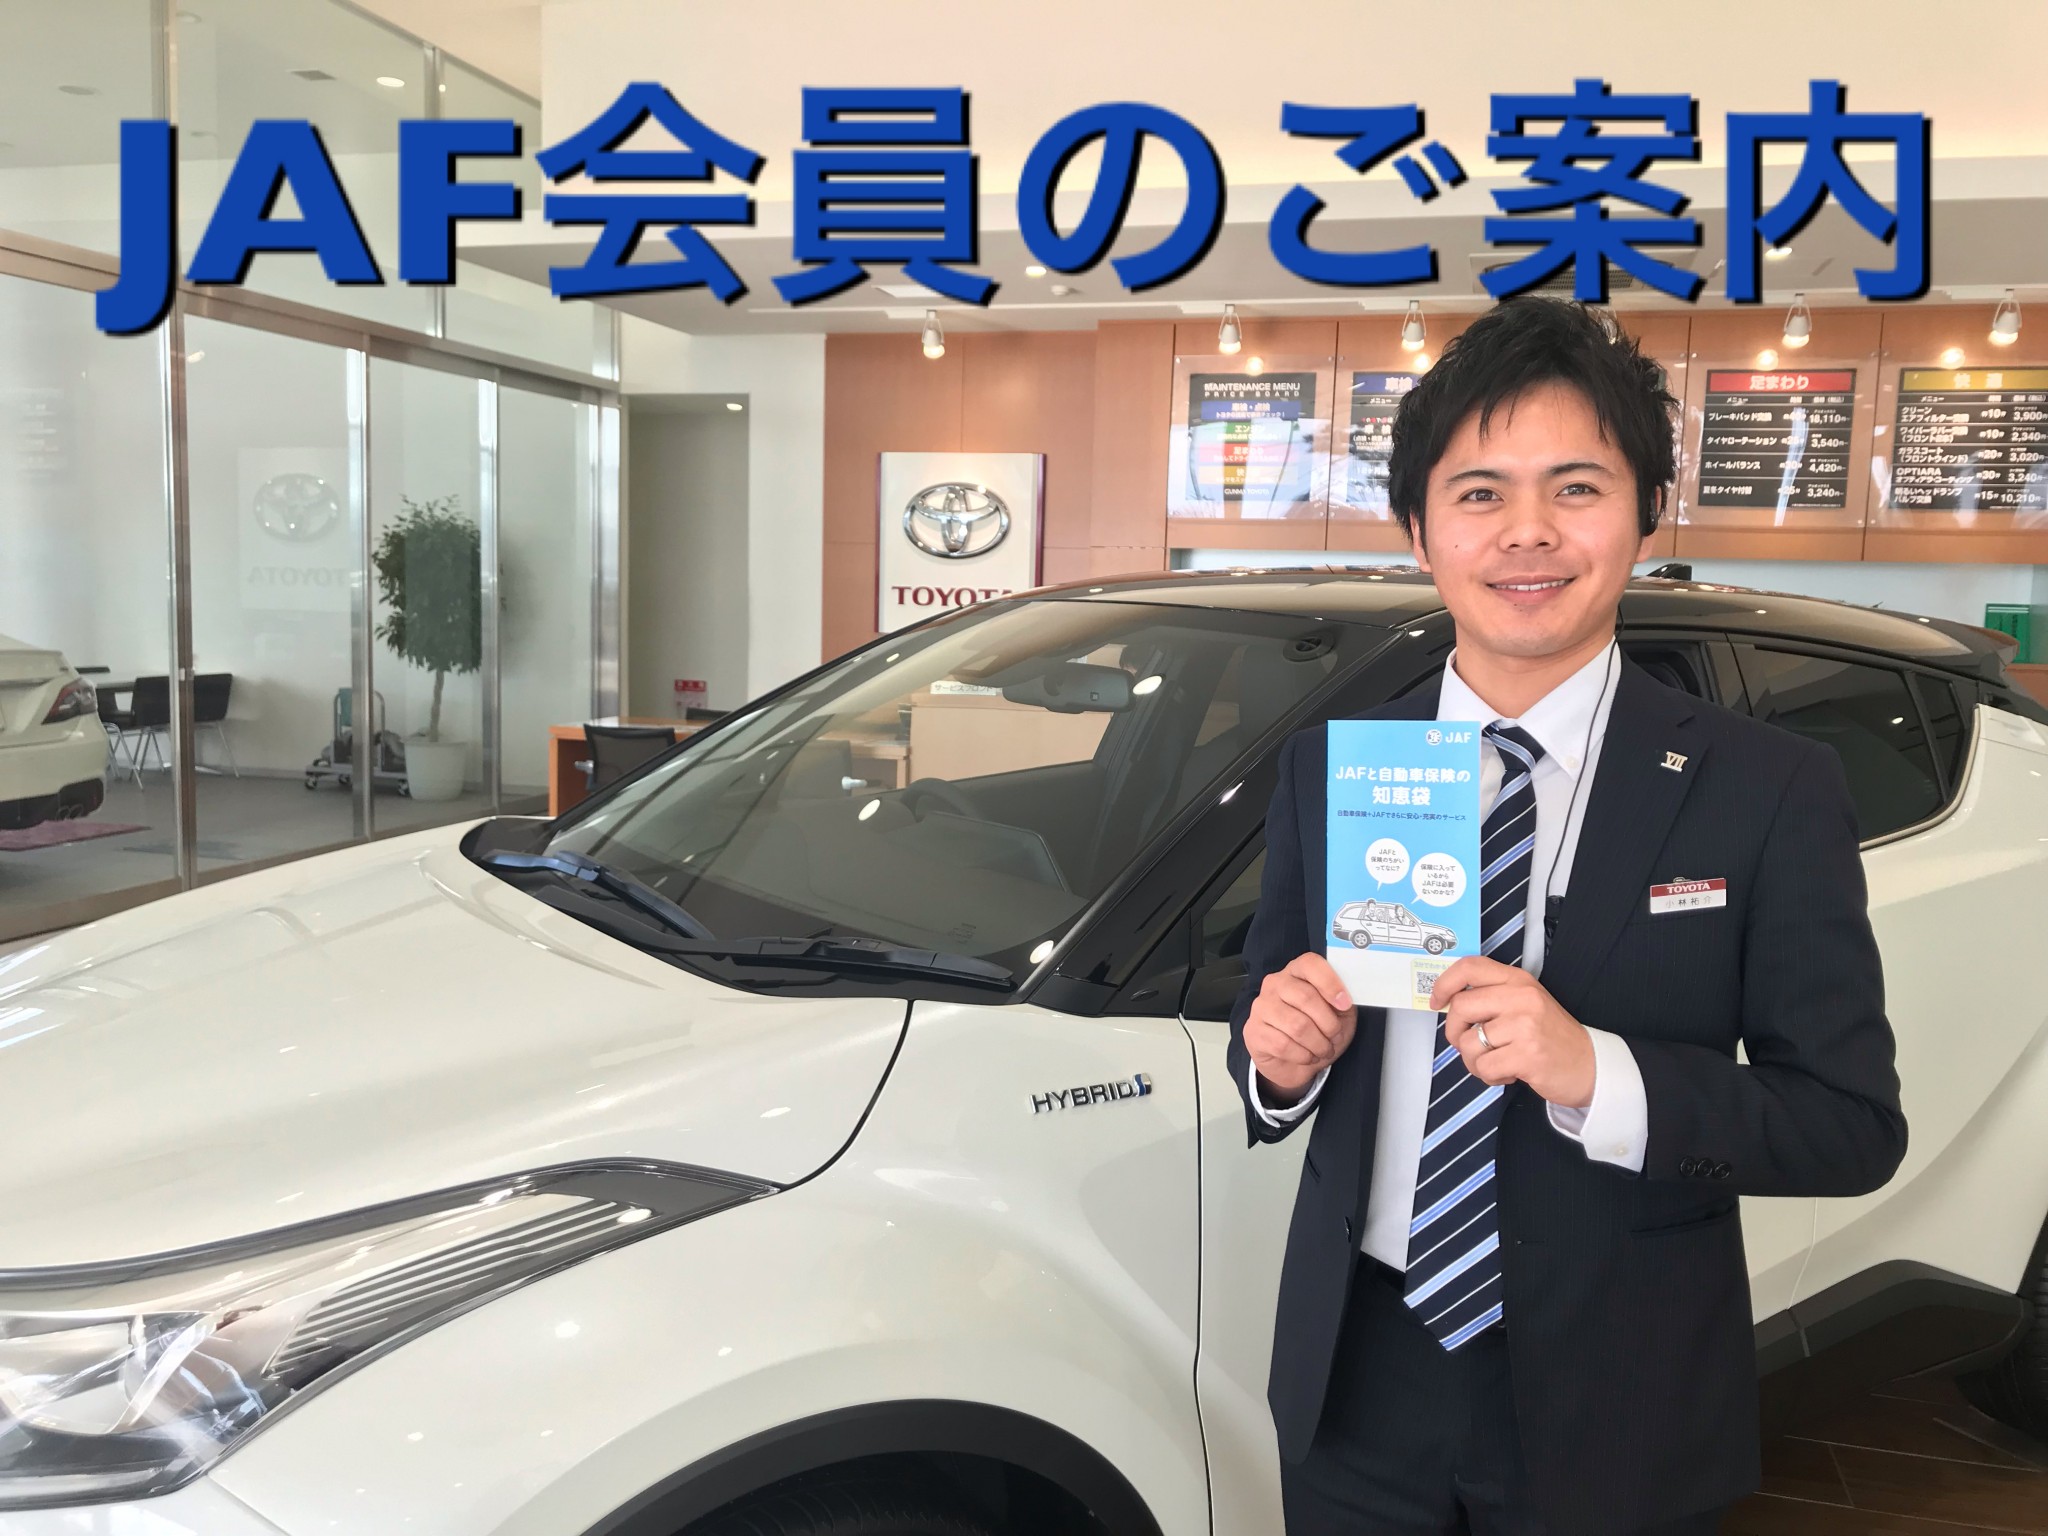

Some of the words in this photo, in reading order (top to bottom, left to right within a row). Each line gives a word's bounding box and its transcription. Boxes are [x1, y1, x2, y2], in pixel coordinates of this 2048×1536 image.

[1204, 382, 1271, 391] MAINTENANCE
[1273, 382, 1300, 391] MENU
[1750, 375, 1809, 390] 足まわり
[1901, 406, 1933, 414] クリーン
[1707, 437, 1777, 445] タイヤローテーション
[1898, 447, 1944, 455] ガラスコート
[1705, 461, 1761, 470] ホイールバランス
[1897, 467, 1942, 476] OPTIARA
[891, 586, 1013, 607] TOYOT
[1445, 732, 1472, 743] JAF
[1335, 766, 1471, 783] JAFと自動車保険の
[1372, 785, 1431, 806] 知恵袋
[1421, 864, 1456, 872] 保険に入って
[1667, 882, 1711, 894] TOYOTA
[1030, 1082, 1133, 1114] HYBRID
